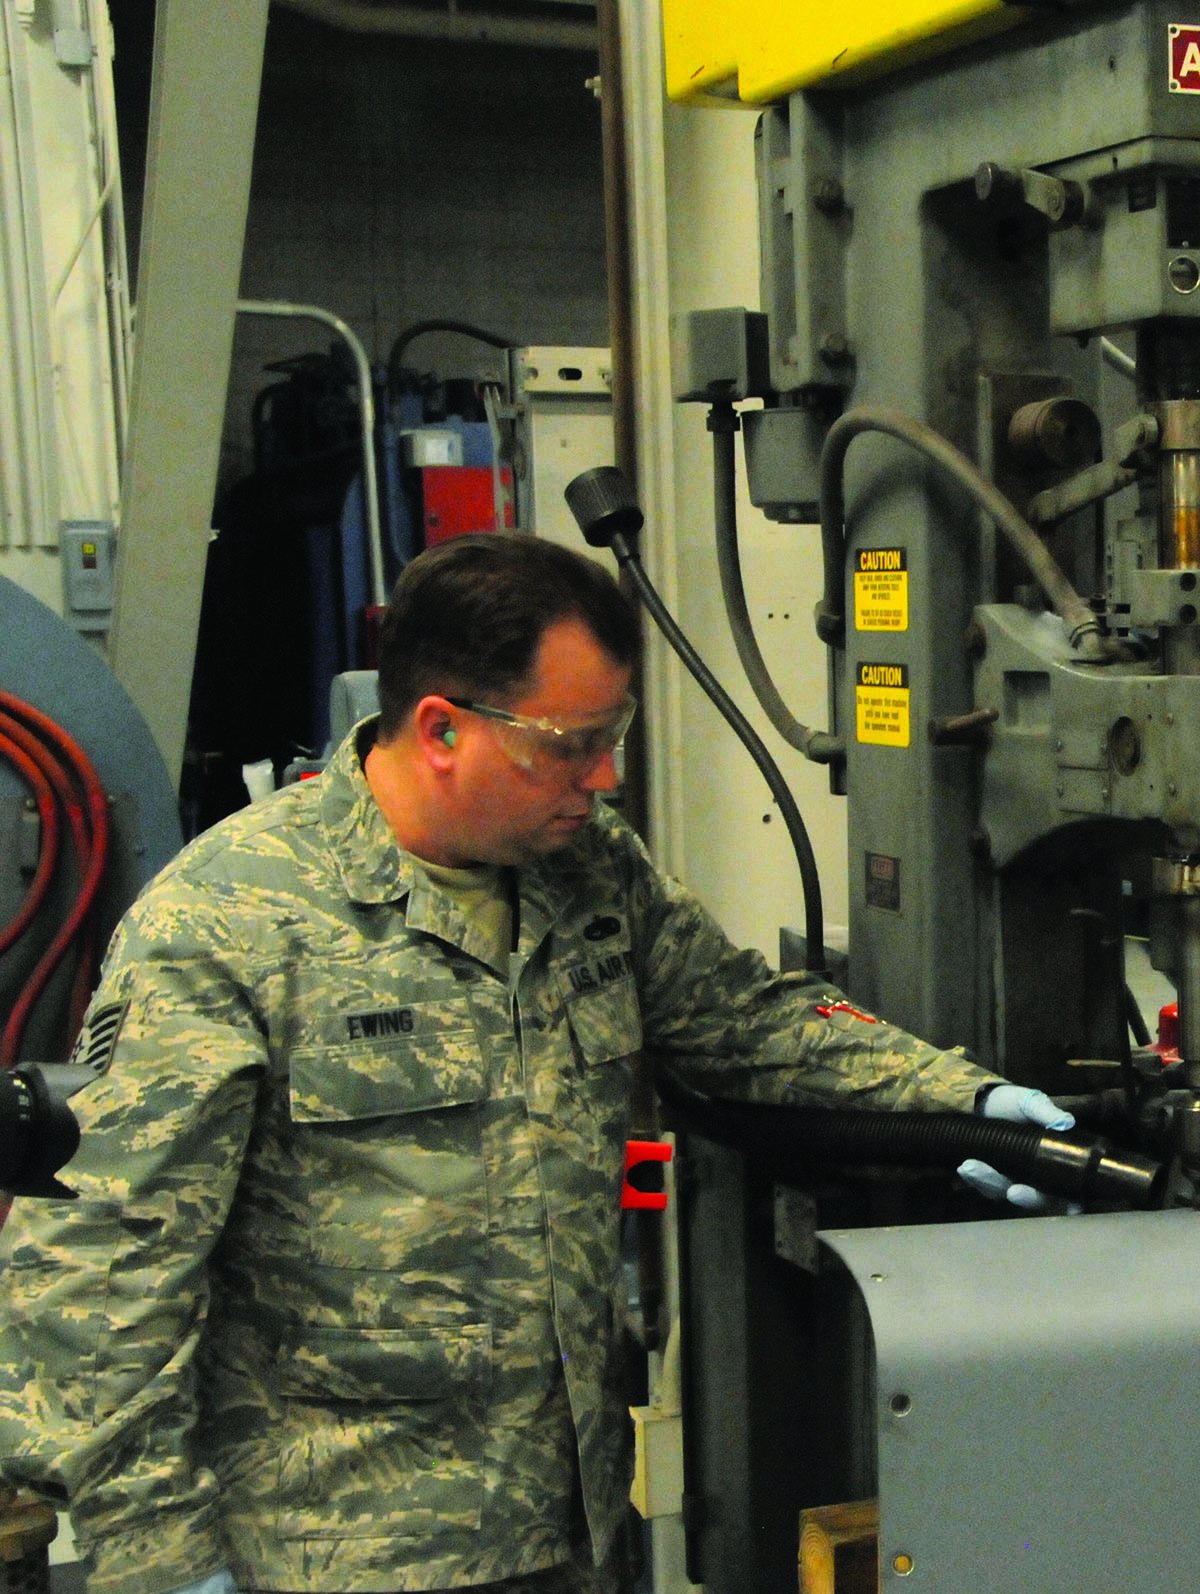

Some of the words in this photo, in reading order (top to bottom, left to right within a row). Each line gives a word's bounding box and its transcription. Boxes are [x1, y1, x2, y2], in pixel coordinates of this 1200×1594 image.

[860, 551, 901, 570] CAUTION
[861, 666, 902, 686] CAUTION
[567, 966, 599, 992] U.S.
[597, 955, 627, 985] AIR
[346, 1009, 414, 1040] EWING
